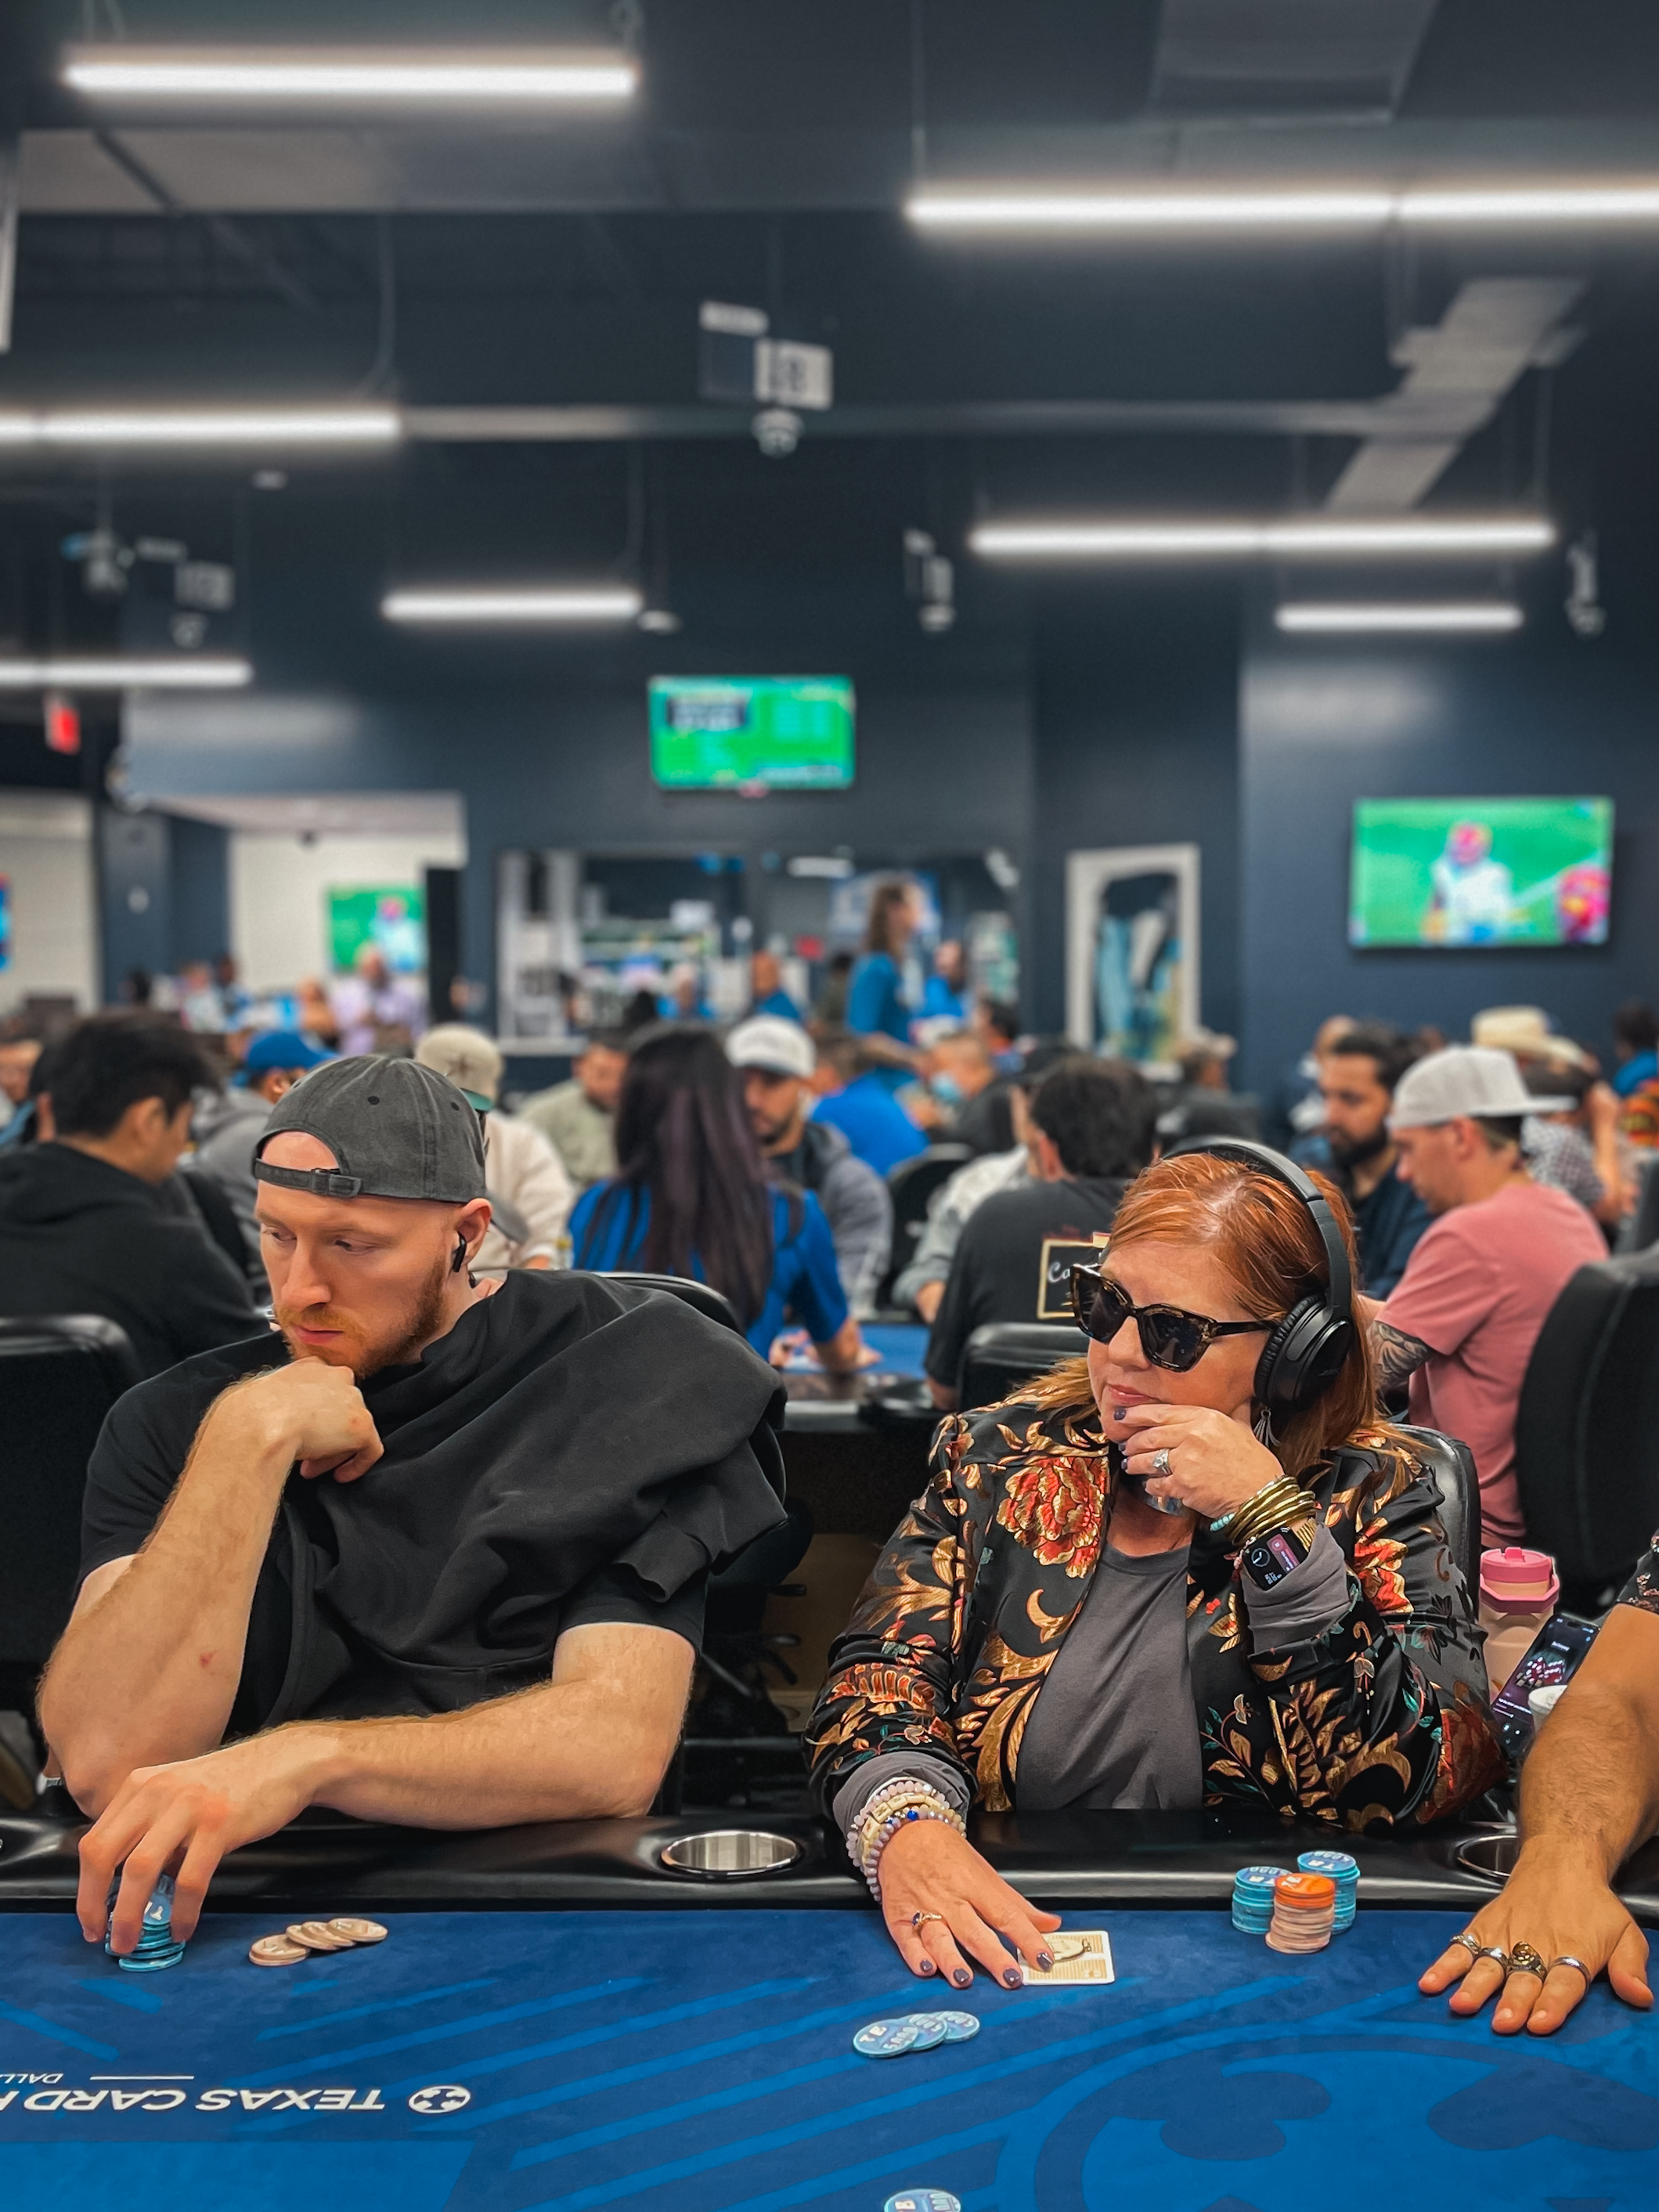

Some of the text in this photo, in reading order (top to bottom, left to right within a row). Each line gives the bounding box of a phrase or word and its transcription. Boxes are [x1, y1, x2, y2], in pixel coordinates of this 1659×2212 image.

[0, 2073, 63, 2084] DALL
[23, 2090, 186, 2111] CARD
[195, 2089, 385, 2111] TEXAS
